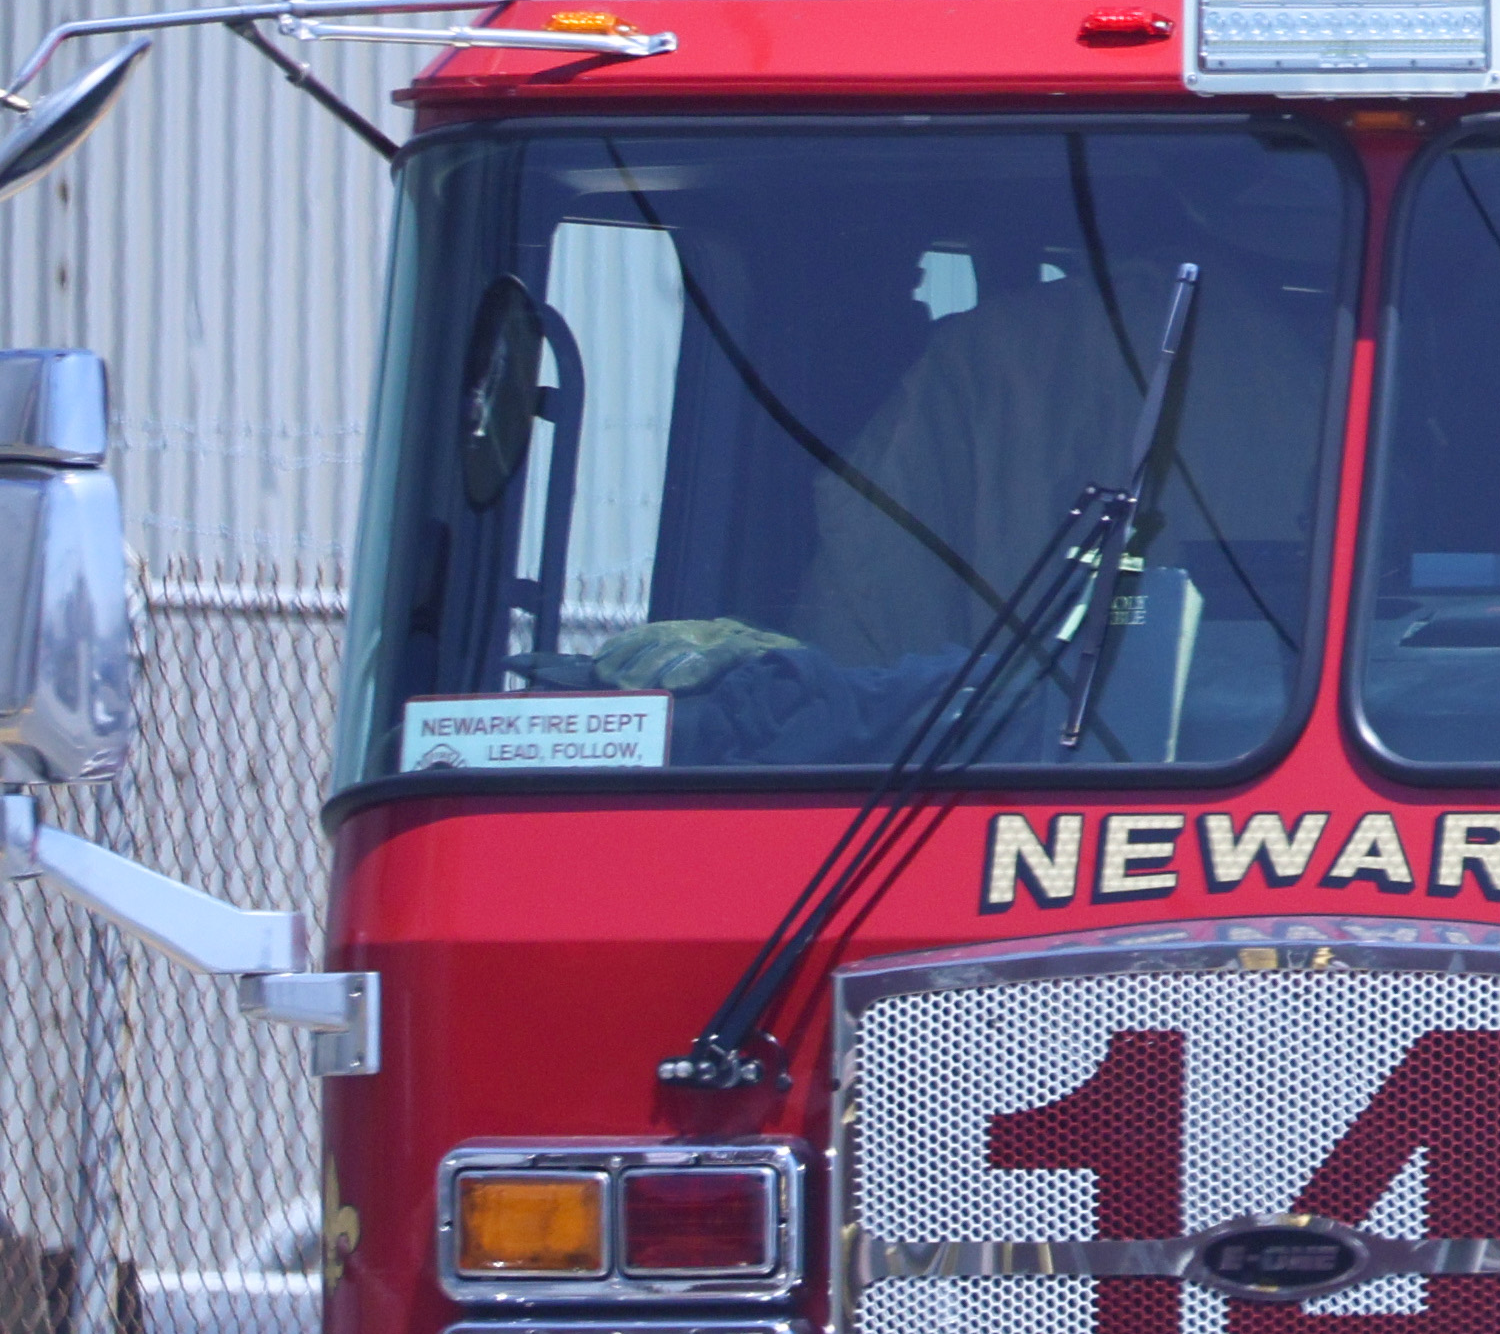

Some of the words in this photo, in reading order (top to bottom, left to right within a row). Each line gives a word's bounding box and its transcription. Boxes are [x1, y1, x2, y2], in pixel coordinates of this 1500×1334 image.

[421, 715, 523, 737] NEWARK
[528, 714, 579, 734] FIRE
[586, 713, 648, 734] DEPT
[551, 742, 643, 761] FOLLOW,
[1218, 1244, 1341, 1272] E-ONE
